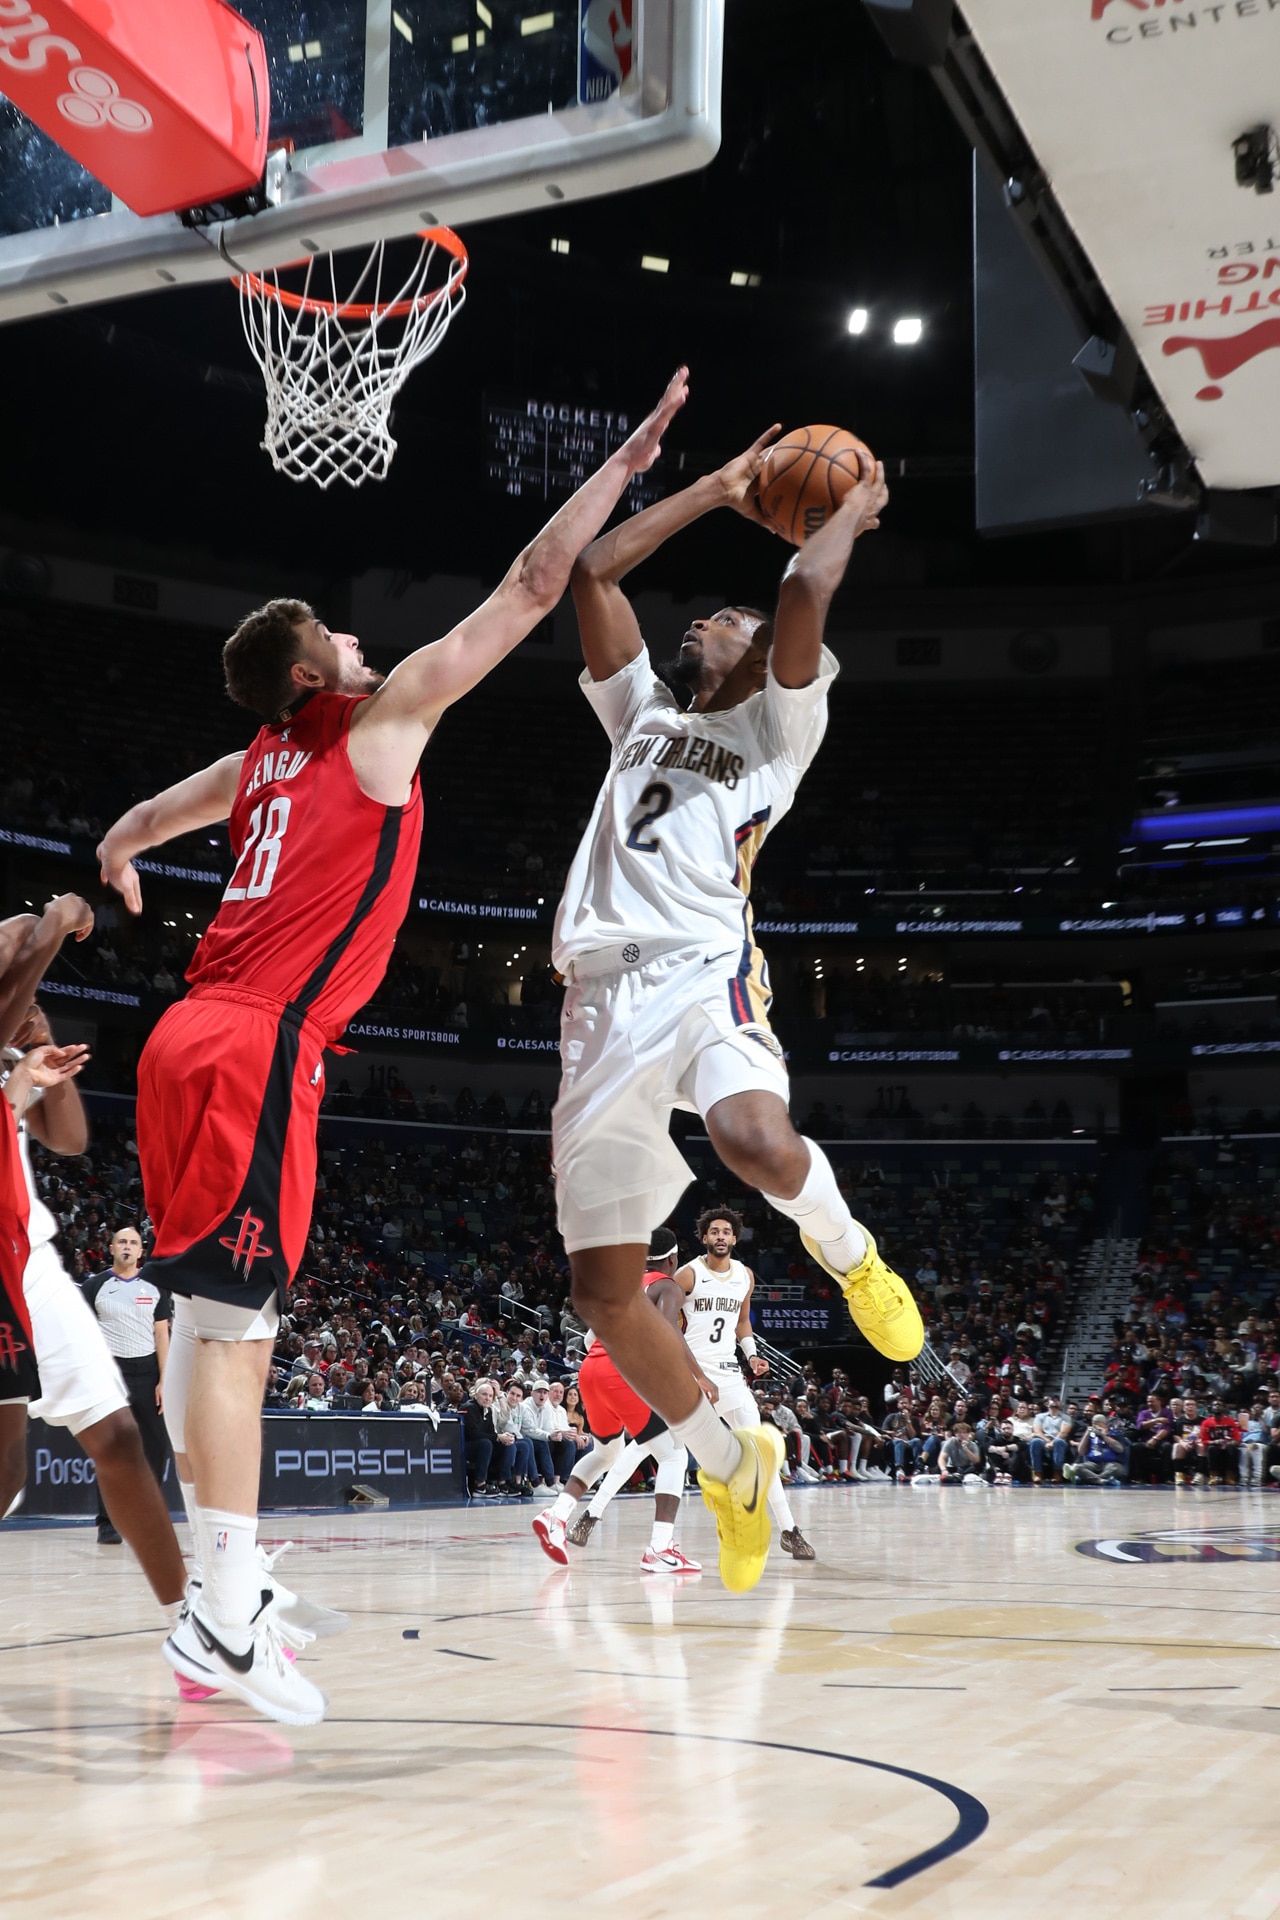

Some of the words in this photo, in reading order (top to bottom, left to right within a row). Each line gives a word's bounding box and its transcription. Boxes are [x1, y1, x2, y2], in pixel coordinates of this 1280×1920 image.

[527, 399, 627, 431] ROCKETS
[653, 736, 744, 791] ORLEANS
[625, 781, 674, 854] 2
[164, 865, 222, 884] SPORTSBOOK
[429, 900, 477, 915] CAESARS
[479, 906, 538, 919] SPORTSBOOK
[798, 922, 858, 933] SPORTSBOOK
[82, 988, 140, 1007] SPORTSBOOK
[349, 1023, 400, 1038] CAESARS
[402, 1029, 460, 1044] SPORTSBOOK
[508, 1038, 560, 1051] CAESARS
[840, 1051, 895, 1061] CAESARS
[896, 1051, 959, 1061] SPORTSBOOK
[694, 1297, 714, 1312] NEW
[762, 1309, 829, 1318] HANCOCK
[709, 1317, 725, 1343] 3
[762, 1319, 829, 1329] WHITNEY
[275, 1450, 452, 1477] PORSCHE
